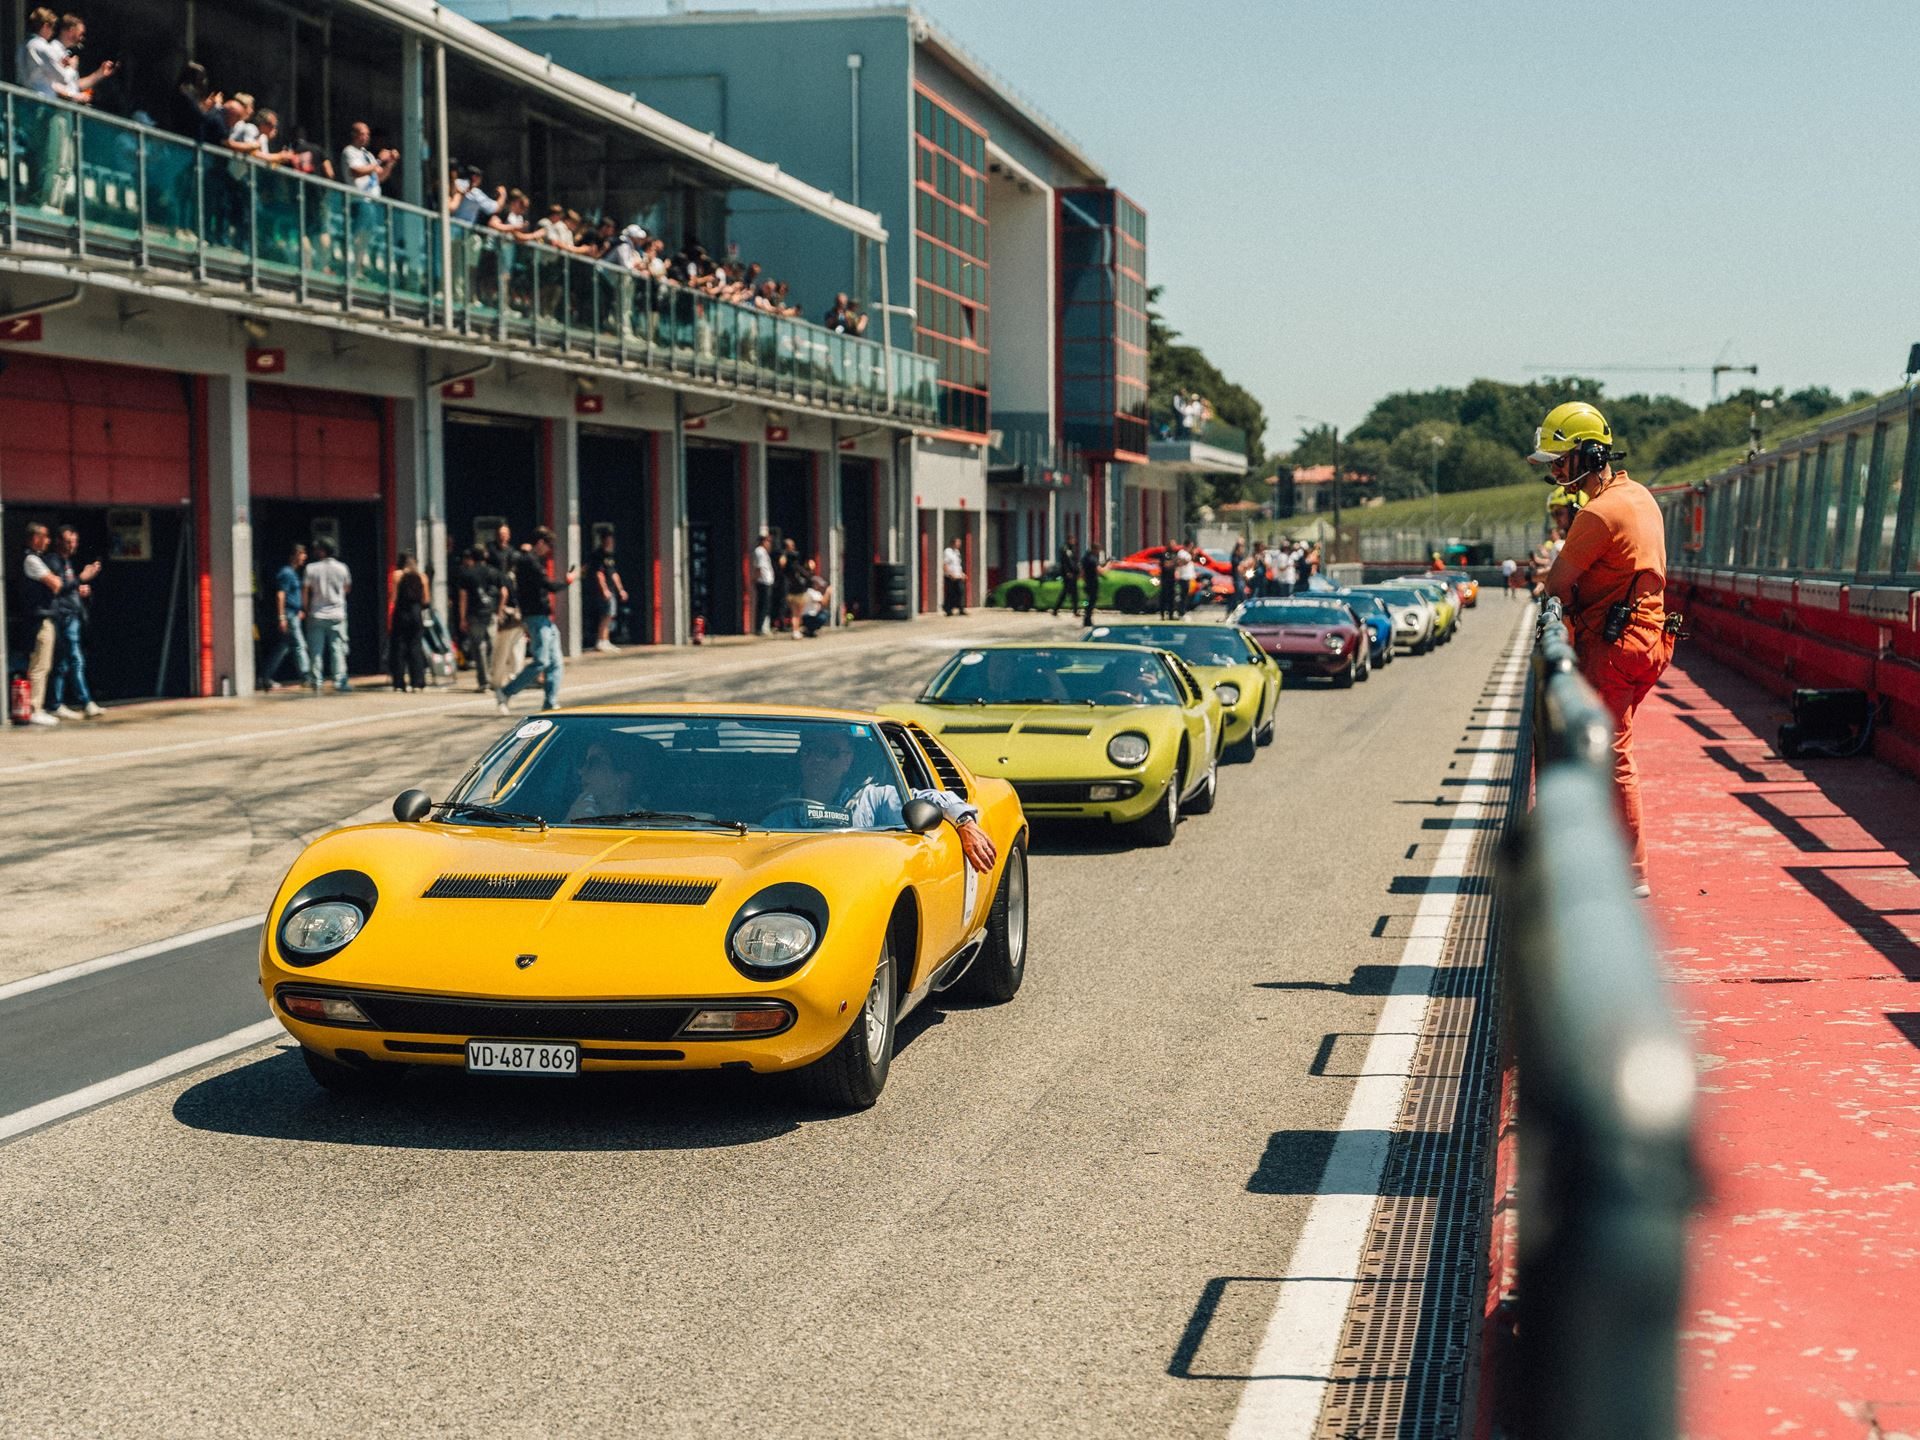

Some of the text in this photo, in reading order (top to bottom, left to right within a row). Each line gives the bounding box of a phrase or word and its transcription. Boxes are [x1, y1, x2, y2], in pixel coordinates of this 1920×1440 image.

[257, 355, 274, 367] 6
[808, 809, 849, 821] POLO STORICO
[539, 1048, 575, 1070] 869
